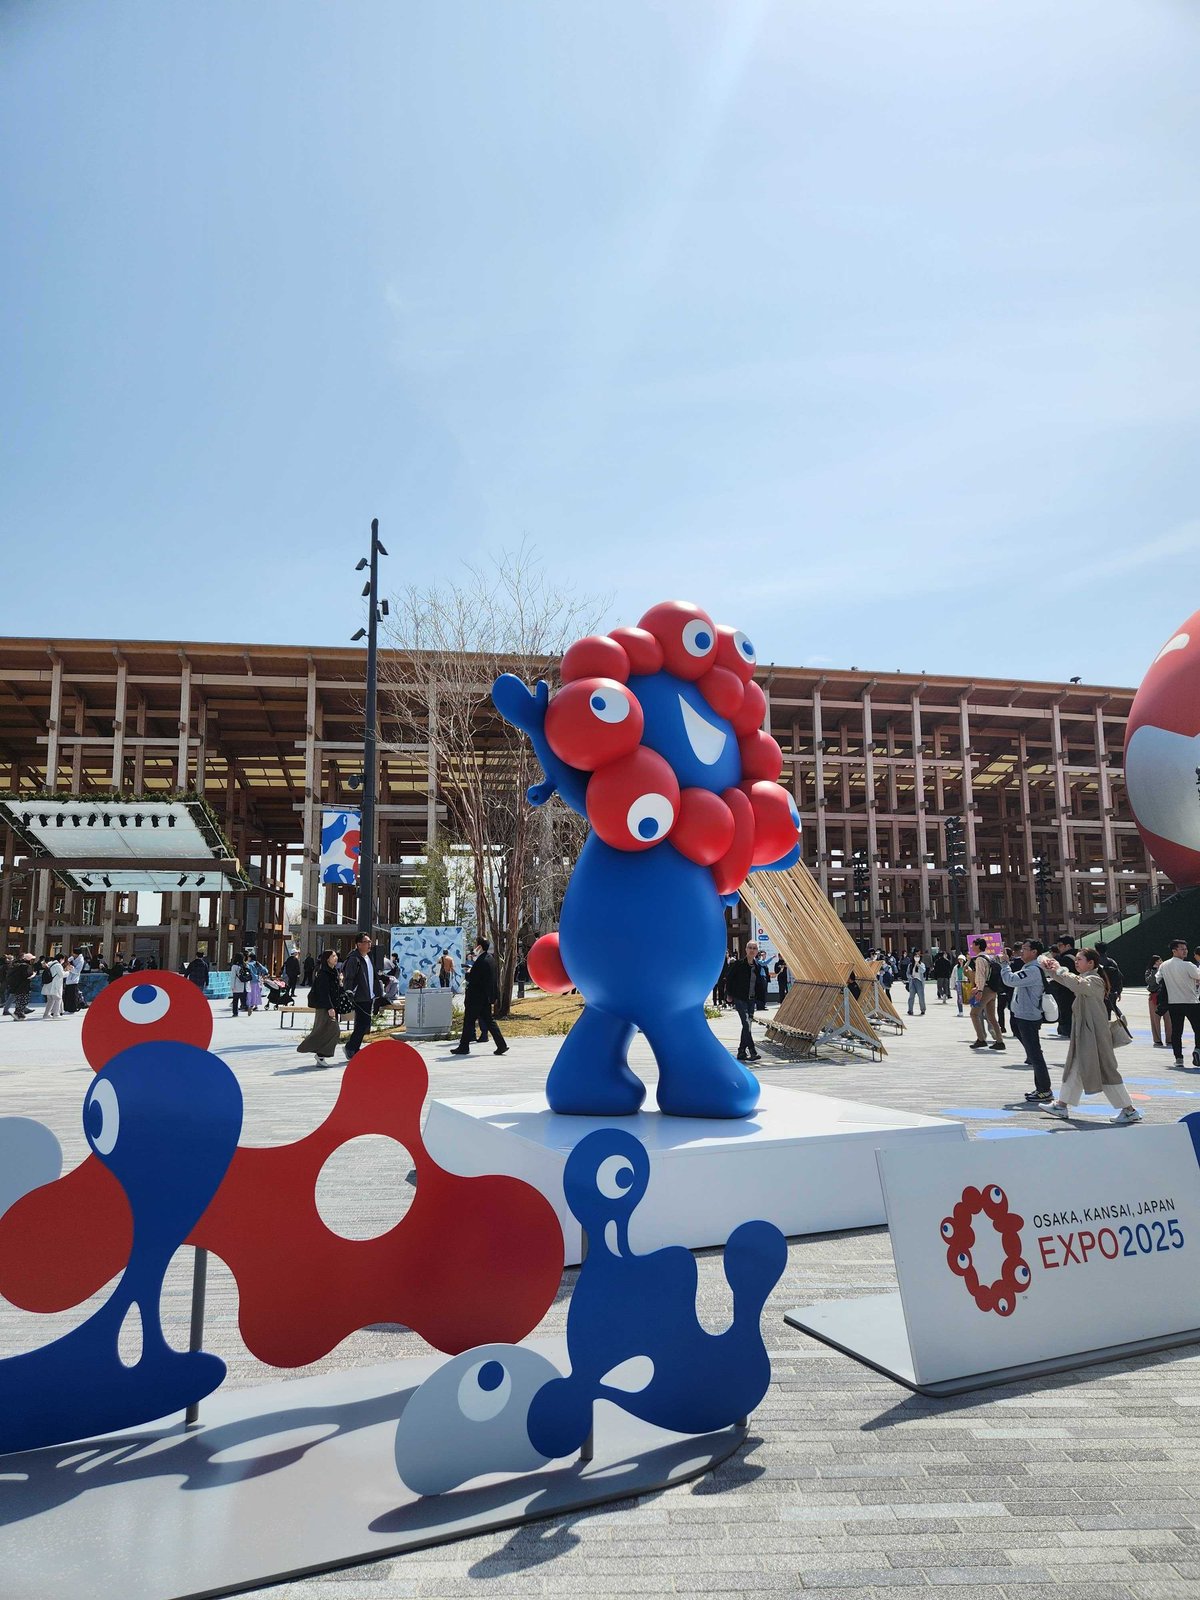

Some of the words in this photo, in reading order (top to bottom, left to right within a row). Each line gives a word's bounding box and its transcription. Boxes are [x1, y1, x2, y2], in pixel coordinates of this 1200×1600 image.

[1033, 1210, 1083, 1228] OSAKA,
[1083, 1204, 1135, 1221] KANSAI,
[1137, 1198, 1175, 1215] JAPAN
[1037, 1218, 1185, 1269] EXPO2025
